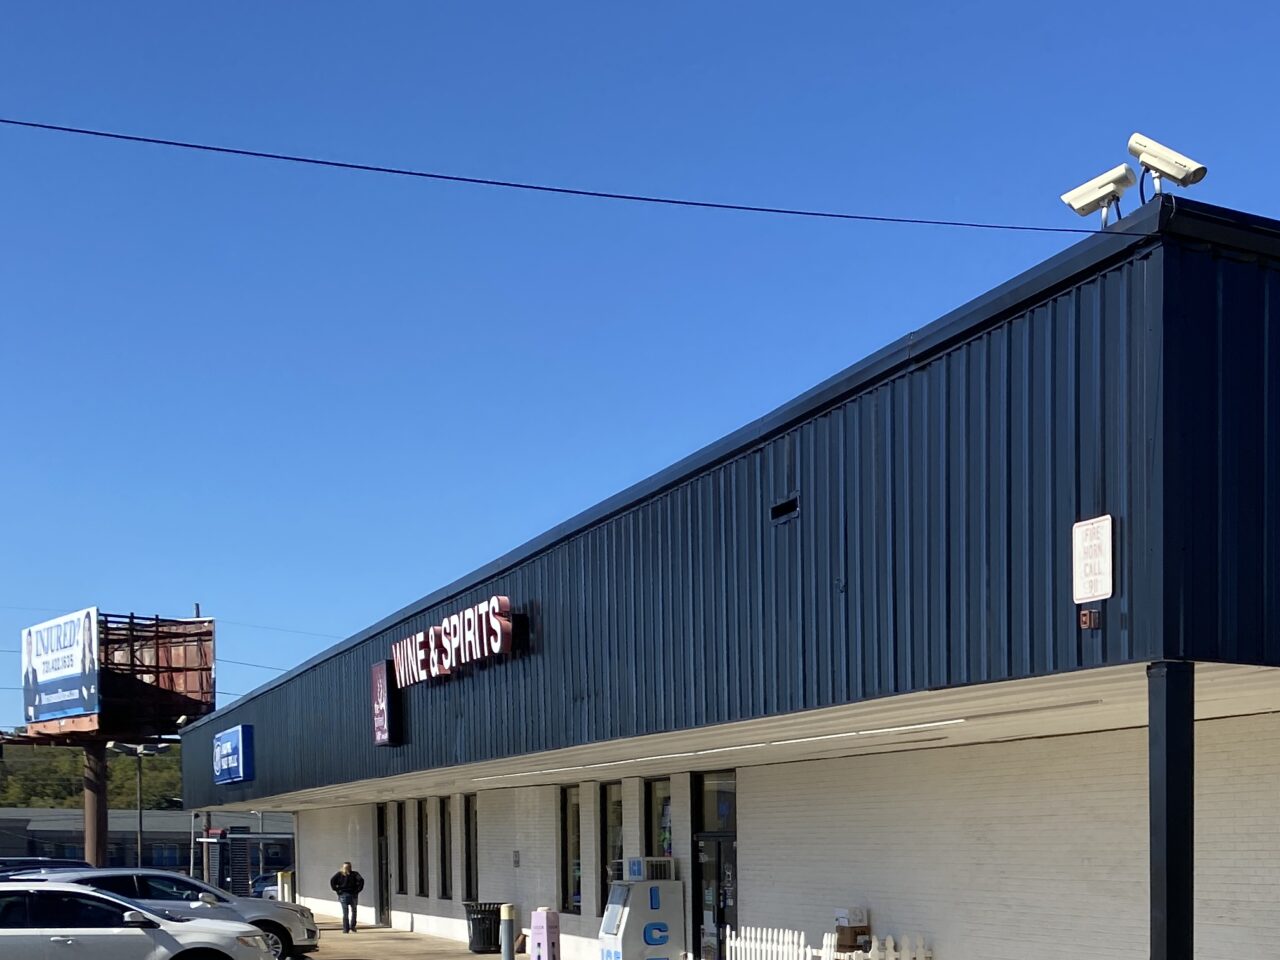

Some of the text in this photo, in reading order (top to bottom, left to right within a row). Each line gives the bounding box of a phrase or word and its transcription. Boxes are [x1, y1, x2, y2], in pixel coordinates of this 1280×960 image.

[1084, 561, 1102, 577] CALL
[35, 618, 81, 657] INJURED?
[392, 595, 501, 688] WINE & SPIRITS
